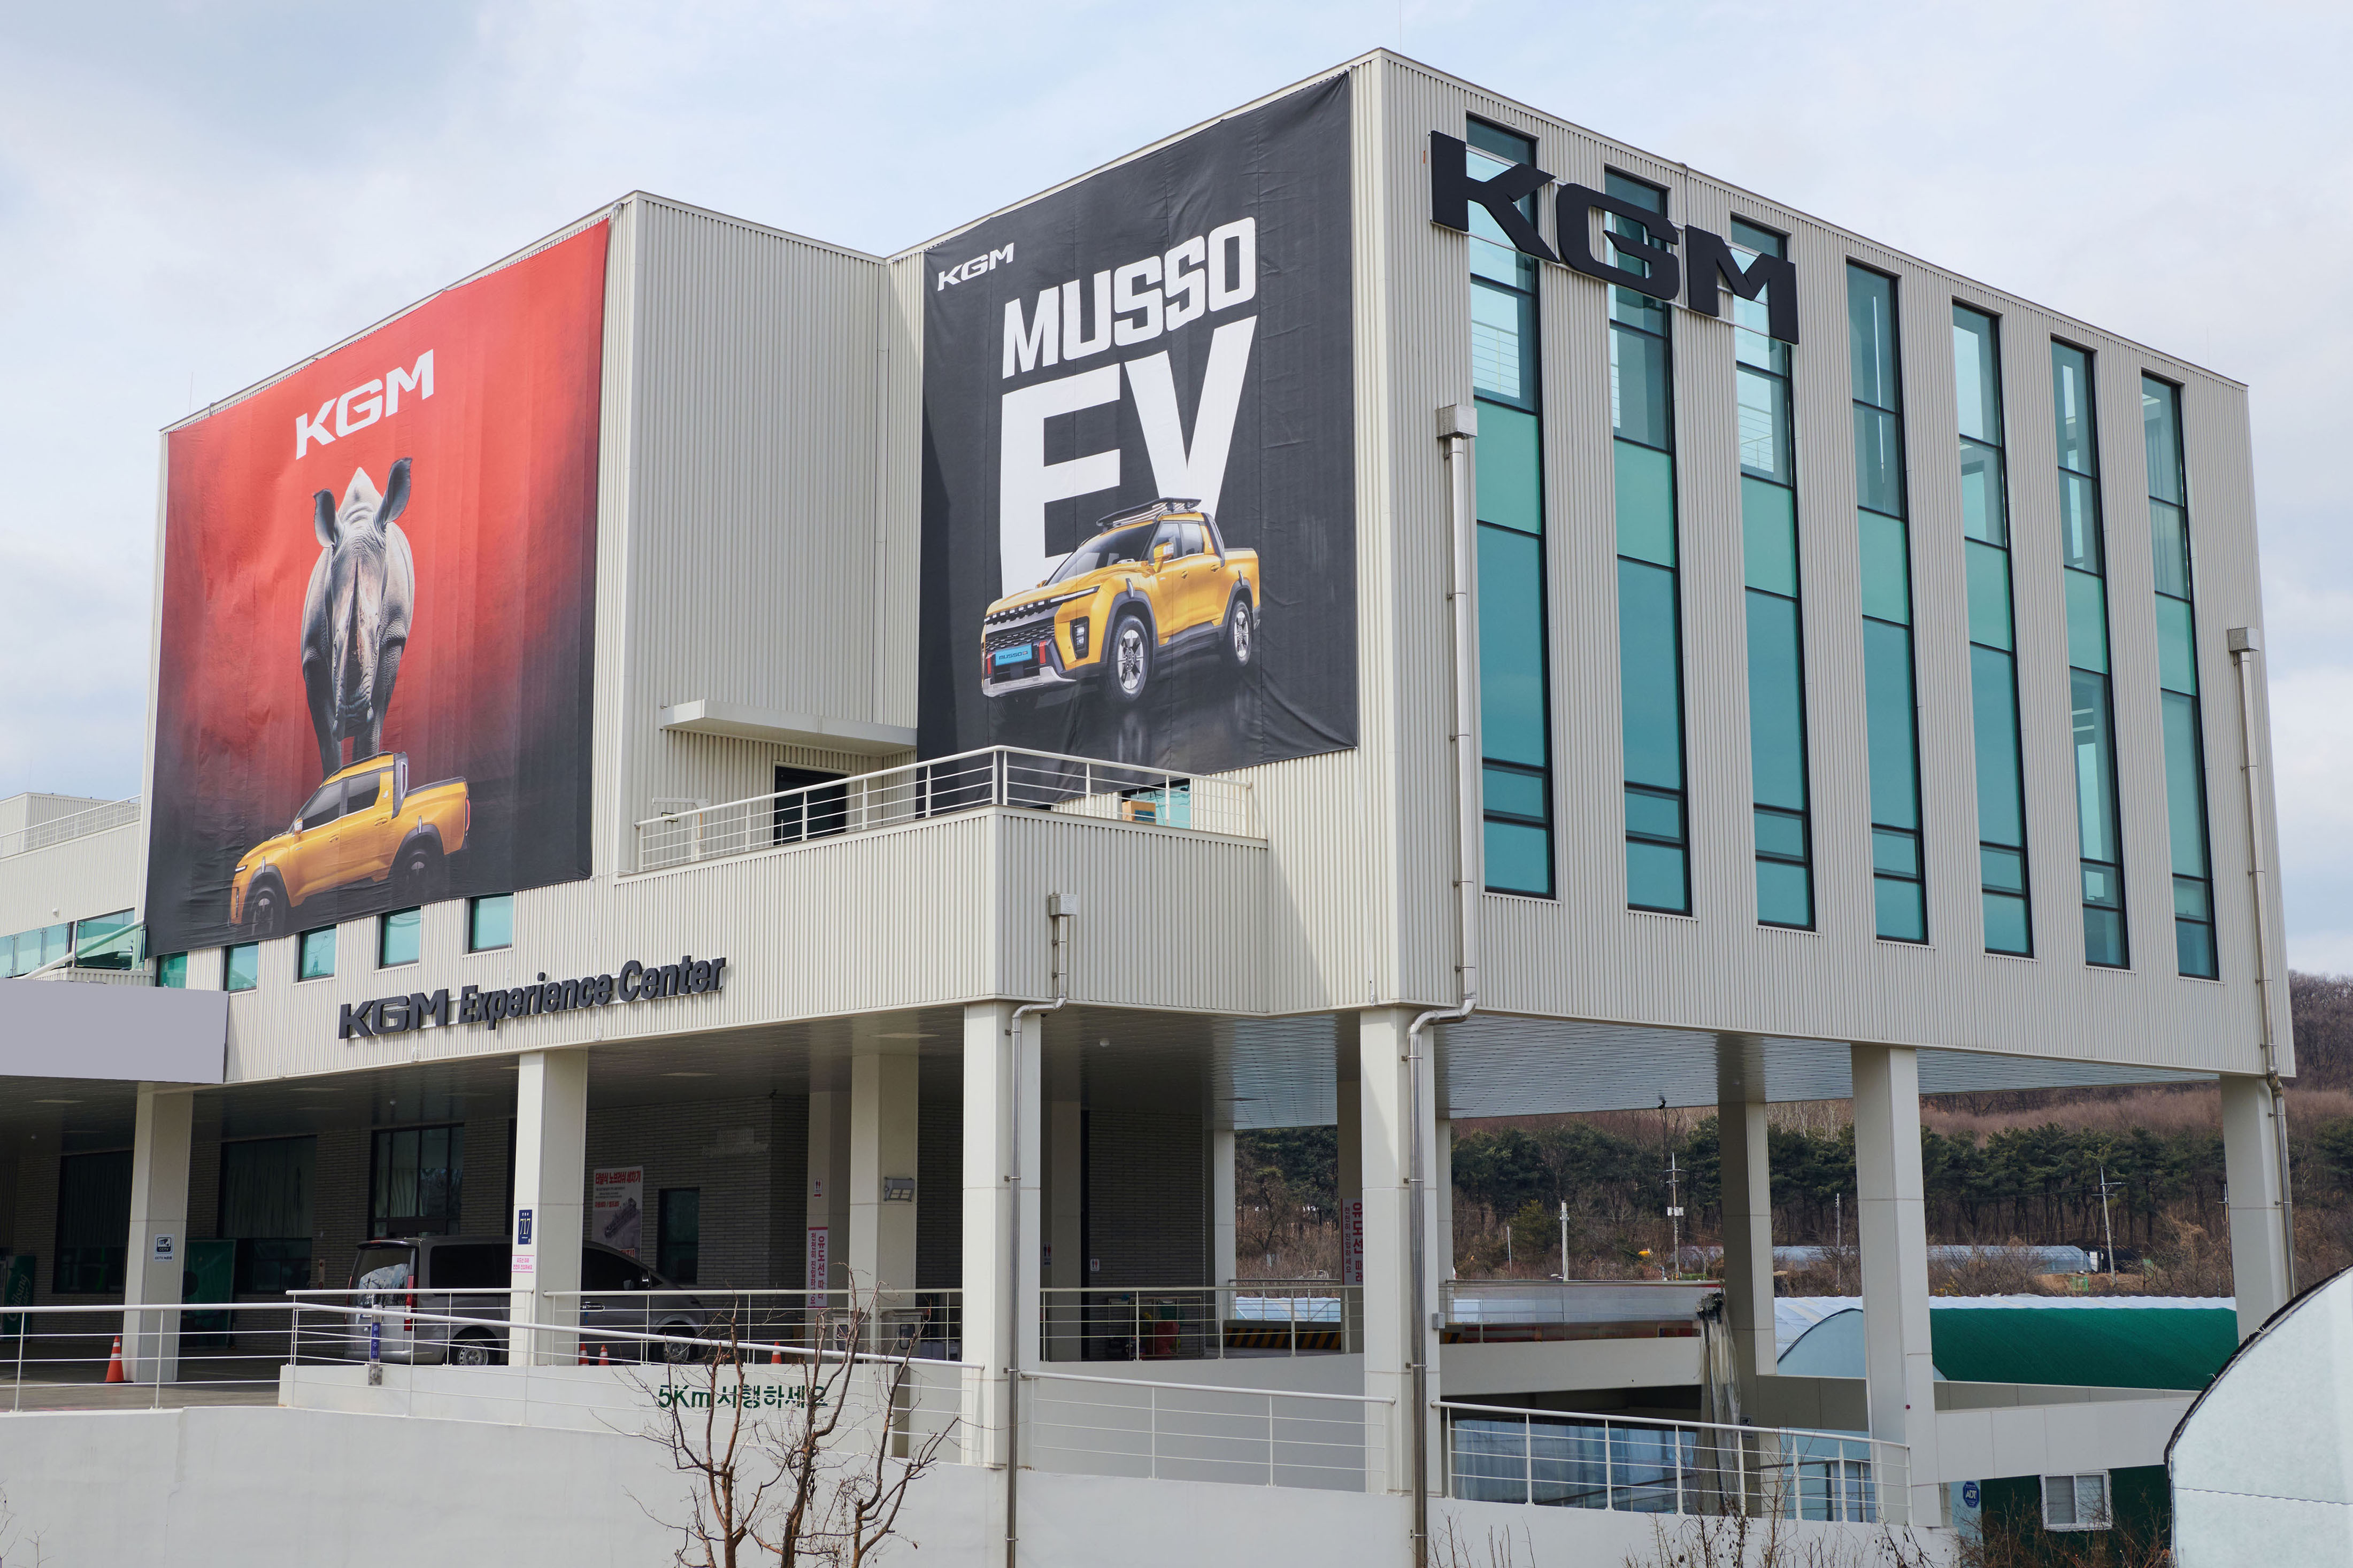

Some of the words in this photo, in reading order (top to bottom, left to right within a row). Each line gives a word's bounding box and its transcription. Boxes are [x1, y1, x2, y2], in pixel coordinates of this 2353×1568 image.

[1431, 130, 1799, 345] KGM
[937, 242, 1014, 291] KGM
[1002, 217, 1256, 379] MUSSO
[296, 349, 434, 460] KGM
[1000, 315, 1257, 598] EV
[338, 988, 449, 1039] KGM
[458, 972, 612, 1030] Experience
[618, 955, 726, 1002] Center
[520, 1218, 530, 1235] 717
[1352, 1202, 1363, 1254] 유도선
[1355, 1260, 1362, 1282] 따라
[658, 1385, 711, 1408] 5Km
[1966, 1490, 1977, 1499] ADT
